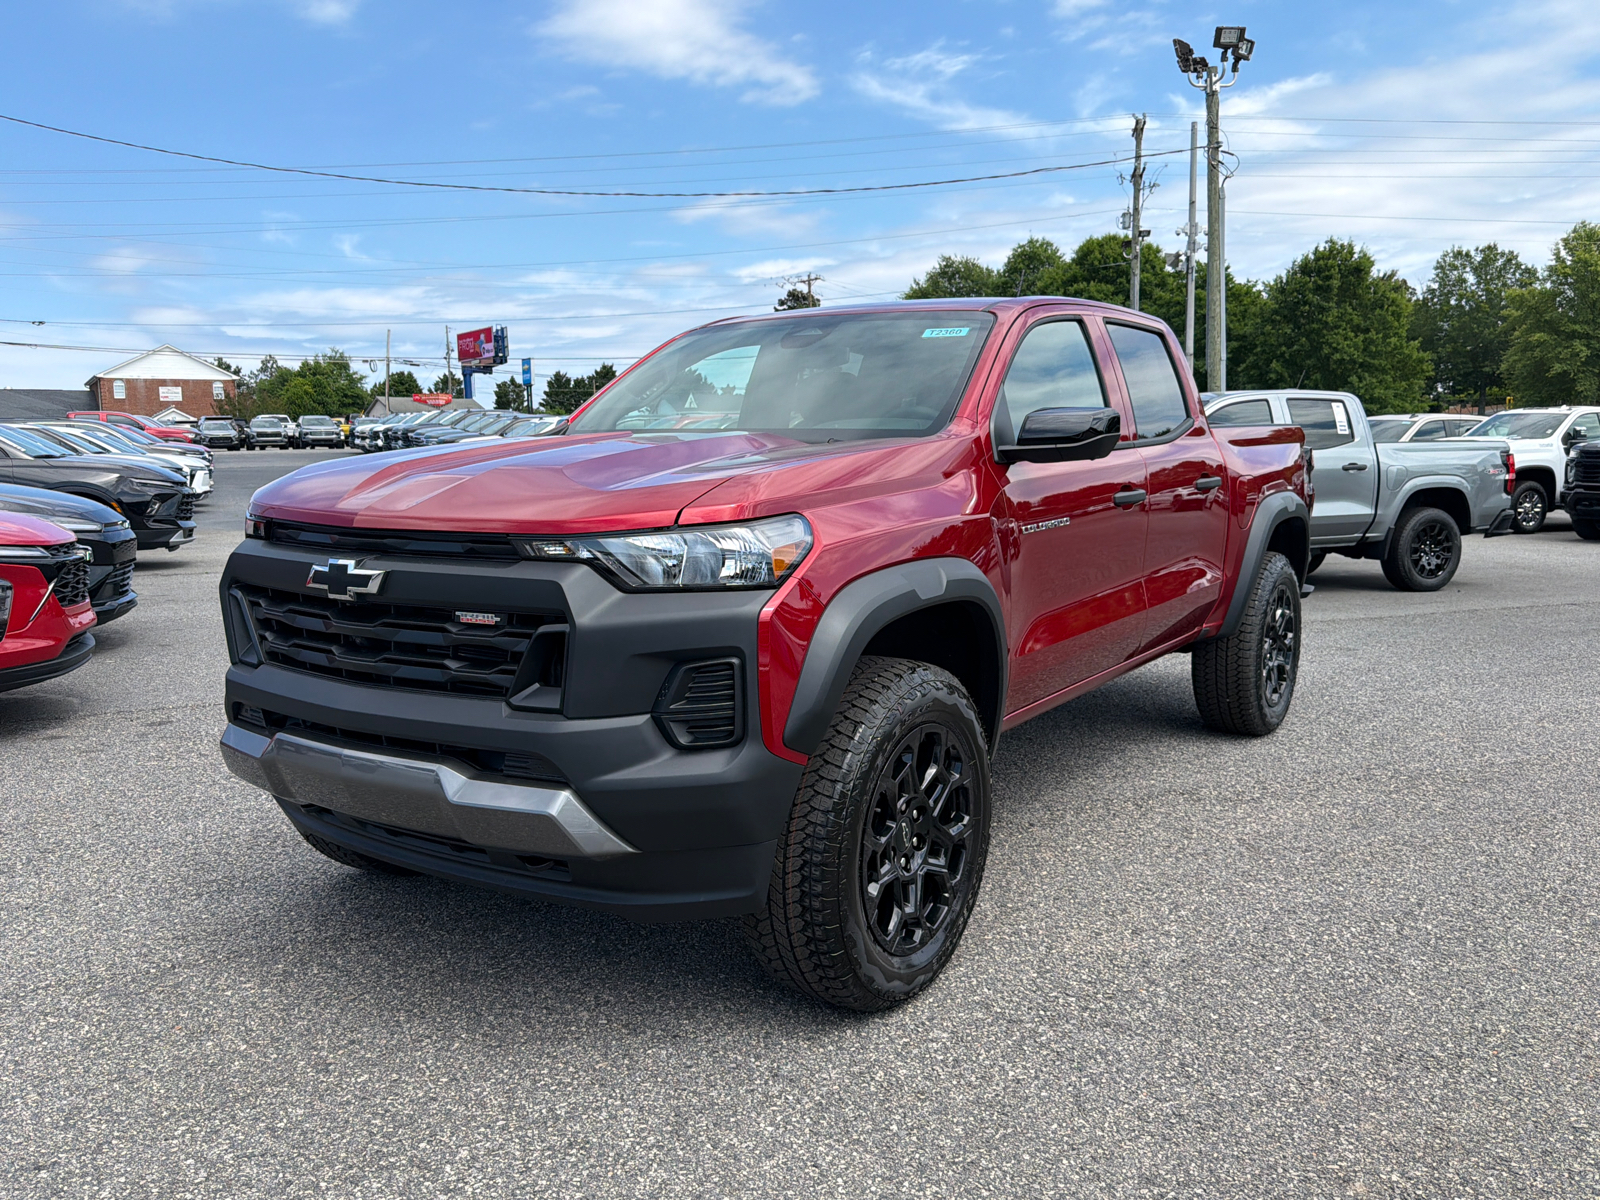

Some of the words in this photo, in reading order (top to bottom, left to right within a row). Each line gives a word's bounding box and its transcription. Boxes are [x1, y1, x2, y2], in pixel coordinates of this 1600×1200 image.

[929, 328, 963, 336] T2360
[1022, 517, 1070, 534] COLORADO
[455, 611, 501, 621] TRAIL
[460, 617, 496, 625] BOSS
